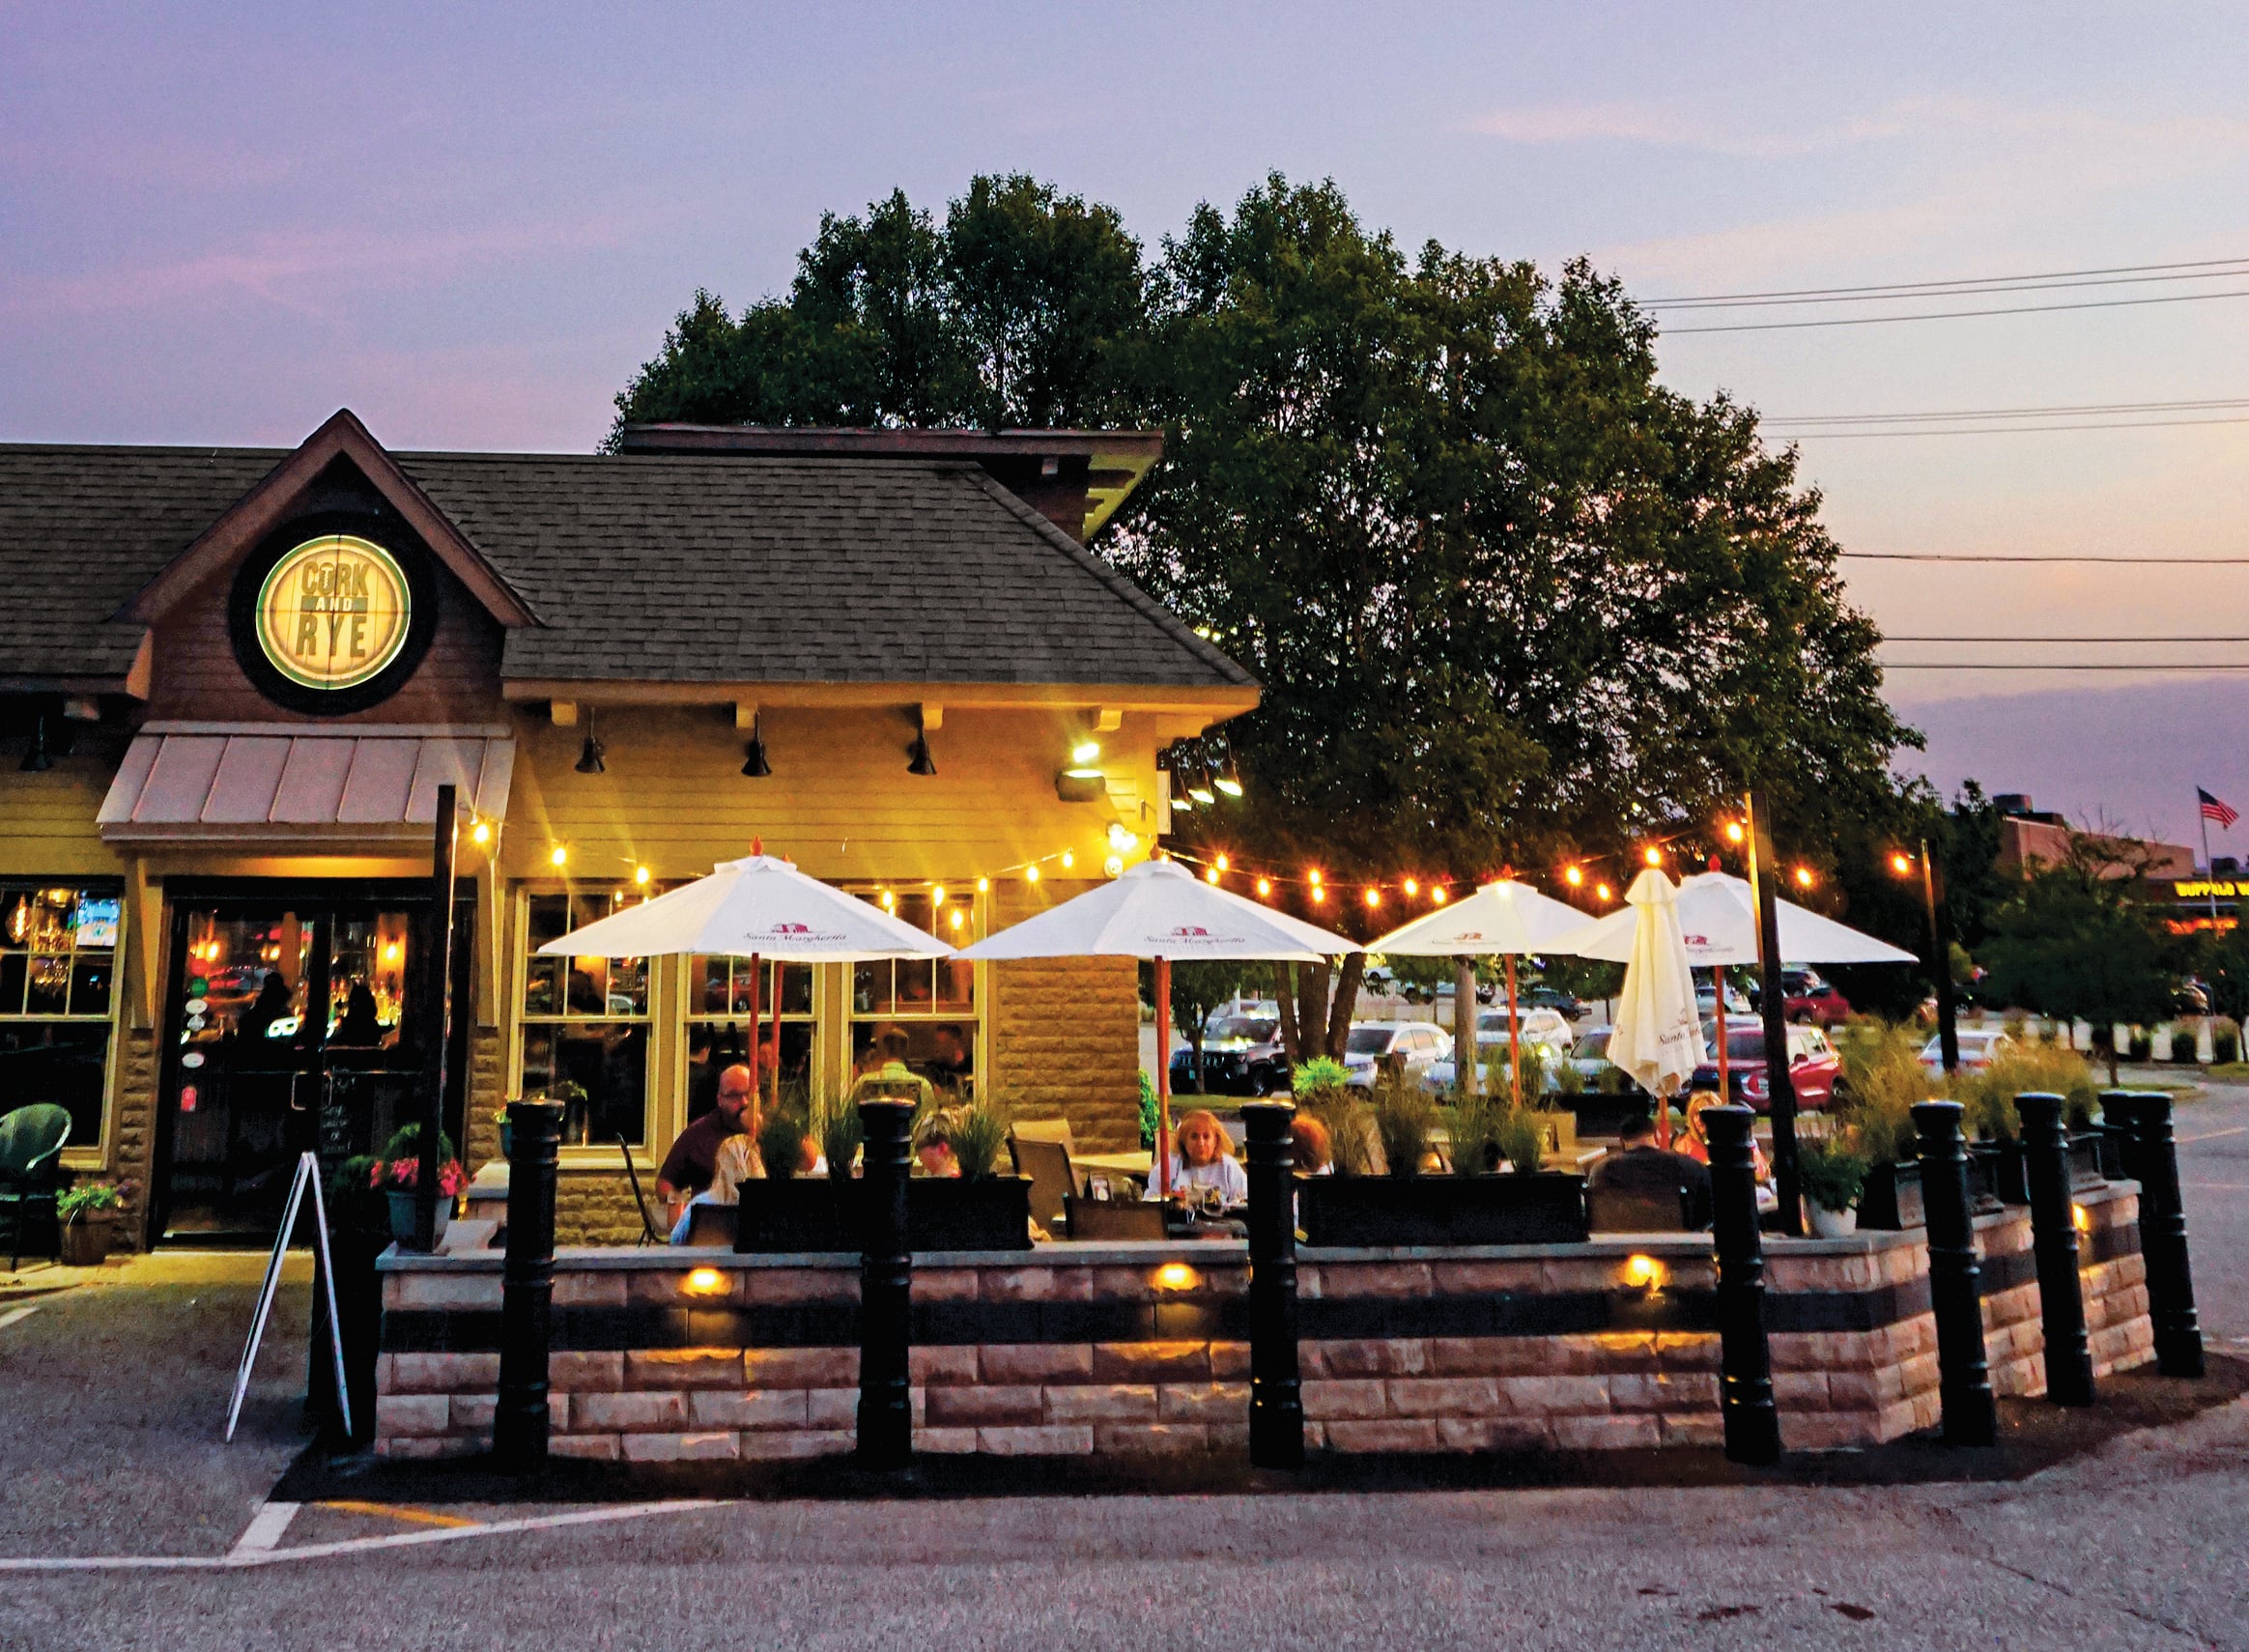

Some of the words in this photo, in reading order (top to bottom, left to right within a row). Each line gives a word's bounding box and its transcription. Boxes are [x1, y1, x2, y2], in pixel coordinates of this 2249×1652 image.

[301, 561, 371, 596] CORK
[315, 597, 353, 612] AND
[296, 613, 367, 657] RYE
[2175, 880, 2235, 897] BUFFALO
[743, 932, 777, 941] Santa
[780, 933, 847, 944] Margherita
[1144, 935, 1177, 944] Santa
[1180, 936, 1246, 945] Margherita
